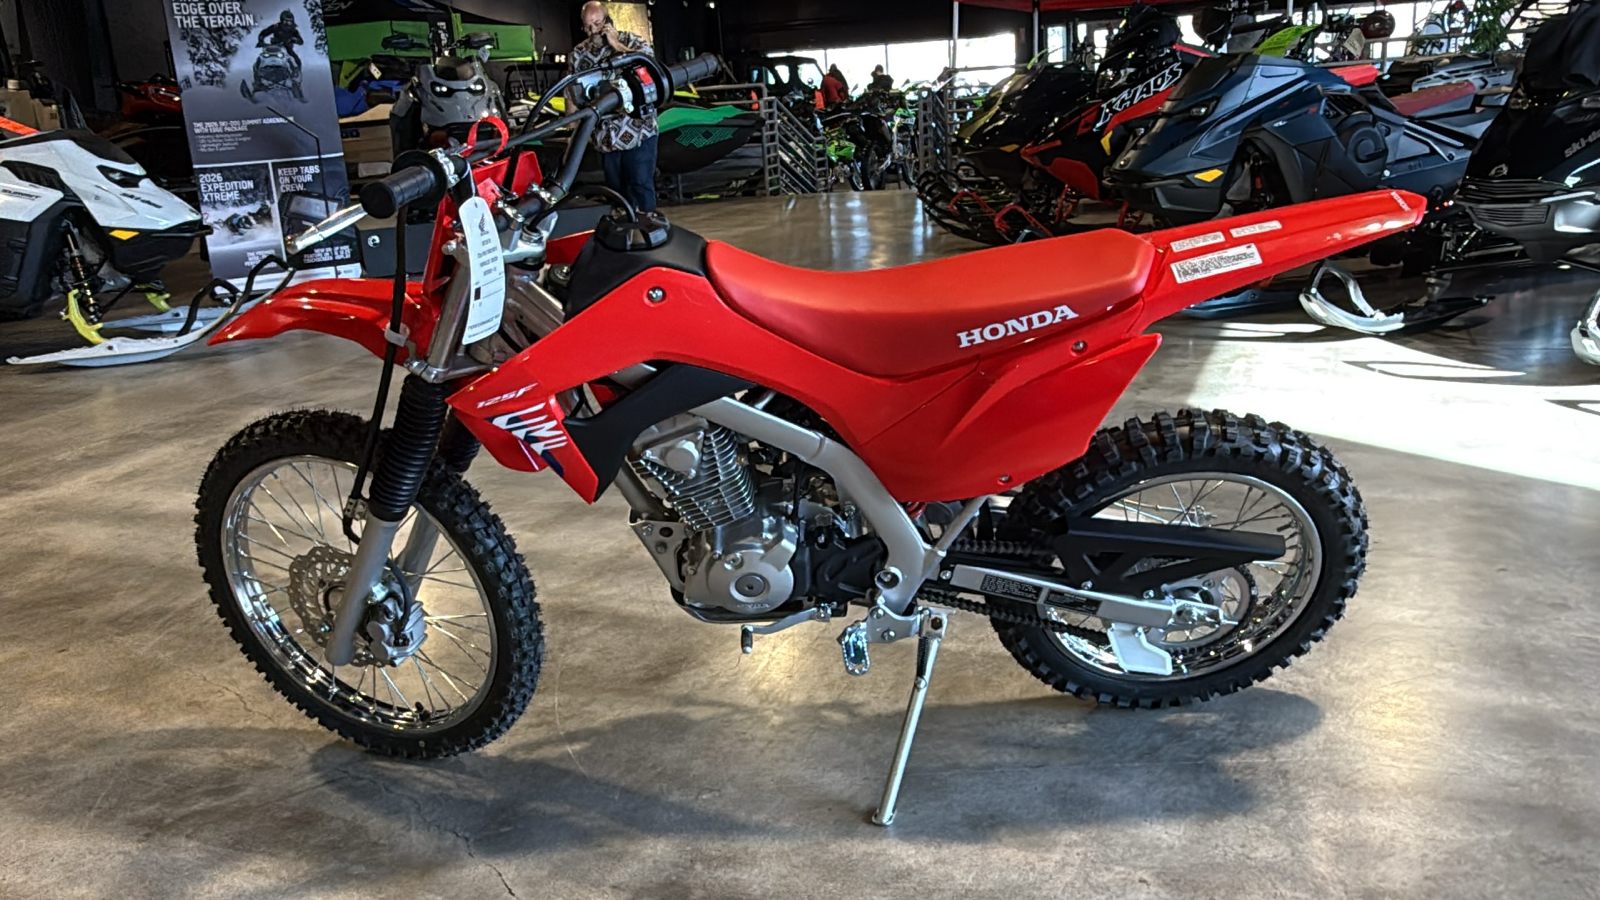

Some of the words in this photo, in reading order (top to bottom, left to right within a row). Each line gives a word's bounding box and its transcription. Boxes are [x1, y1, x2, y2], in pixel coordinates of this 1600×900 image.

[172, 3, 206, 15] EDGE
[208, 2, 241, 15] OVER
[174, 16, 200, 28] THE
[201, 14, 258, 28] TERRAIN.
[1093, 62, 1182, 132] KHAOS
[278, 167, 298, 176] KEEP
[300, 165, 320, 174] TABS
[200, 173, 223, 183] 2026
[280, 176, 291, 184] ON
[292, 174, 313, 183] YOUR
[201, 180, 254, 192] EXPEDITION
[281, 183, 306, 193] CREW.
[202, 190, 240, 202] XTREME
[956, 304, 1079, 348] HONDA
